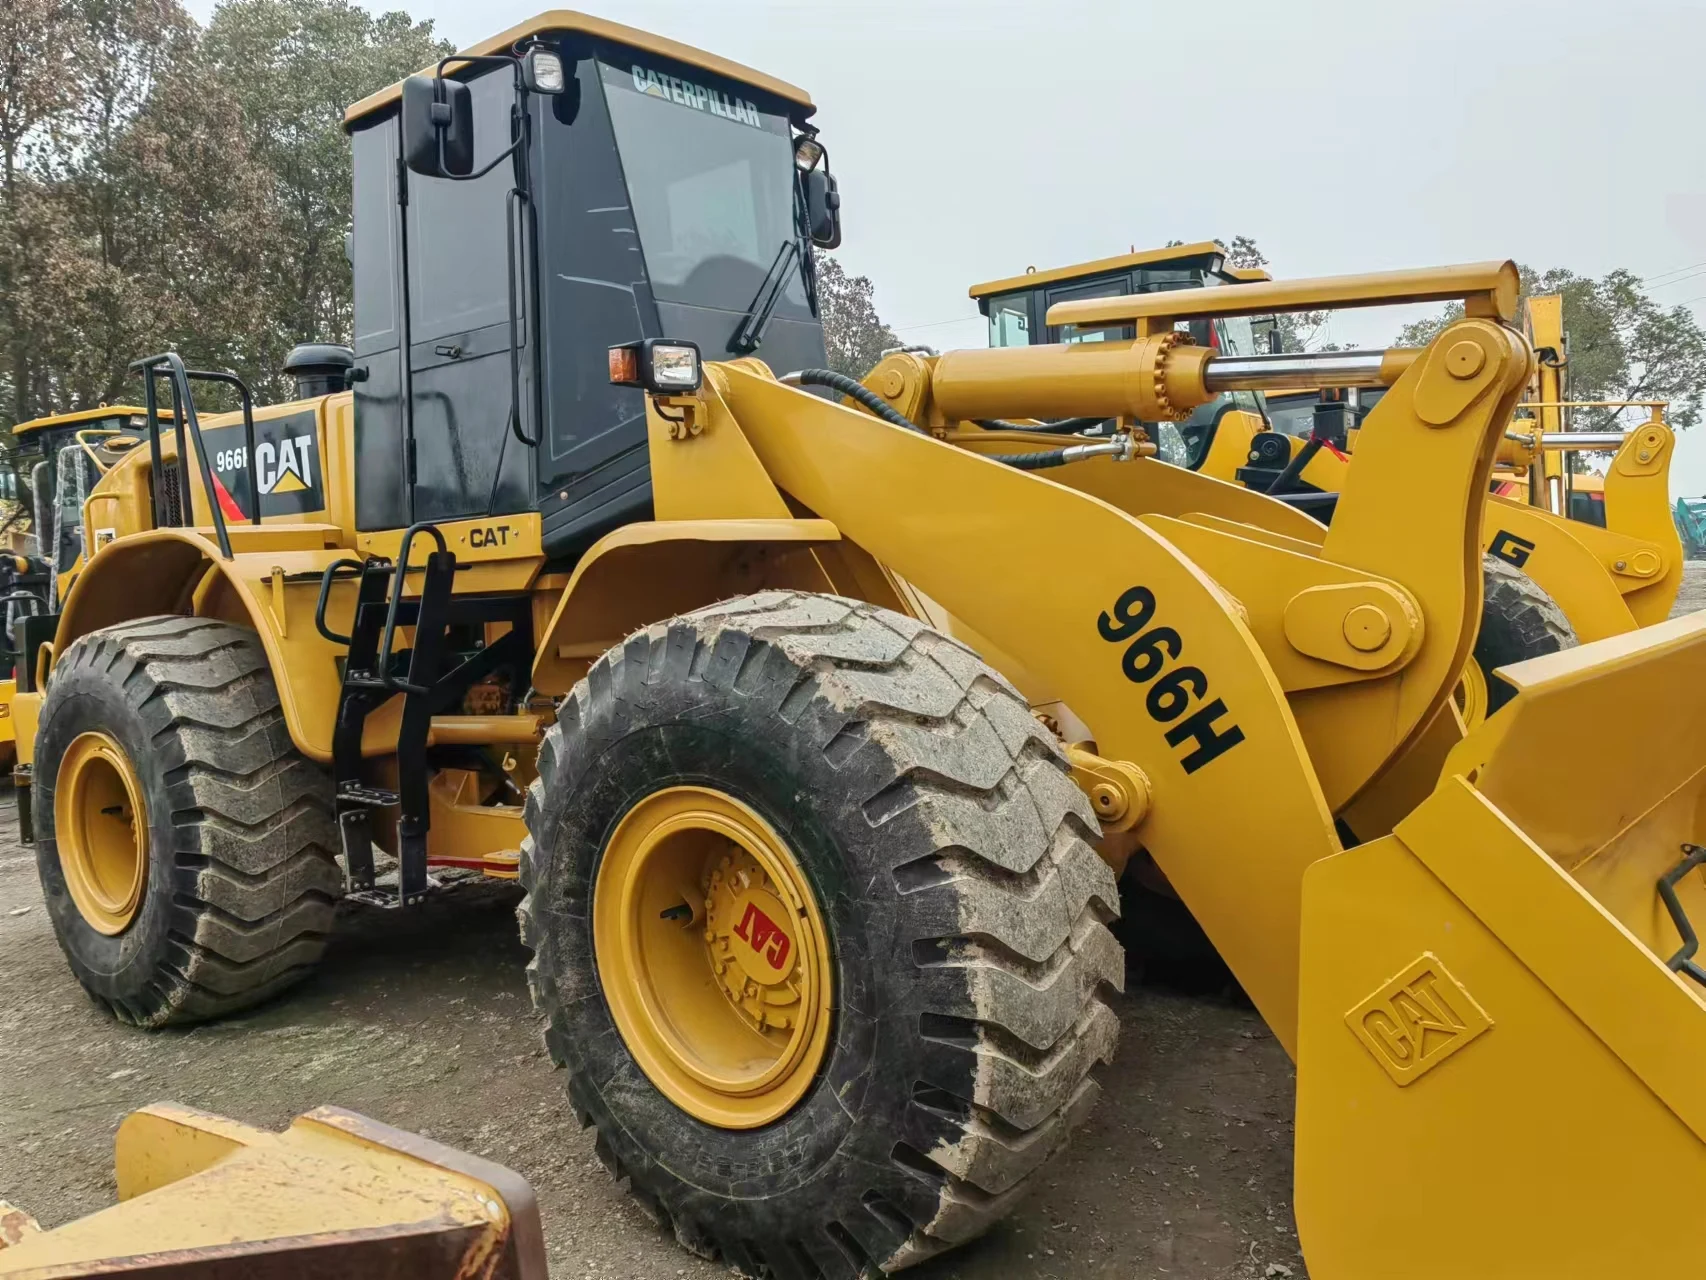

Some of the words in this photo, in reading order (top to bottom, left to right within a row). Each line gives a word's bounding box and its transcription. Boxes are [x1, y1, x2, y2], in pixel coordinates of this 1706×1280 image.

[631, 65, 761, 128] CATERPILLAR
[255, 434, 312, 494] CAT
[470, 525, 510, 548] CAT
[1097, 585, 1246, 775] 966H
[733, 901, 791, 970] CAT
[1363, 970, 1467, 1070] CAT
